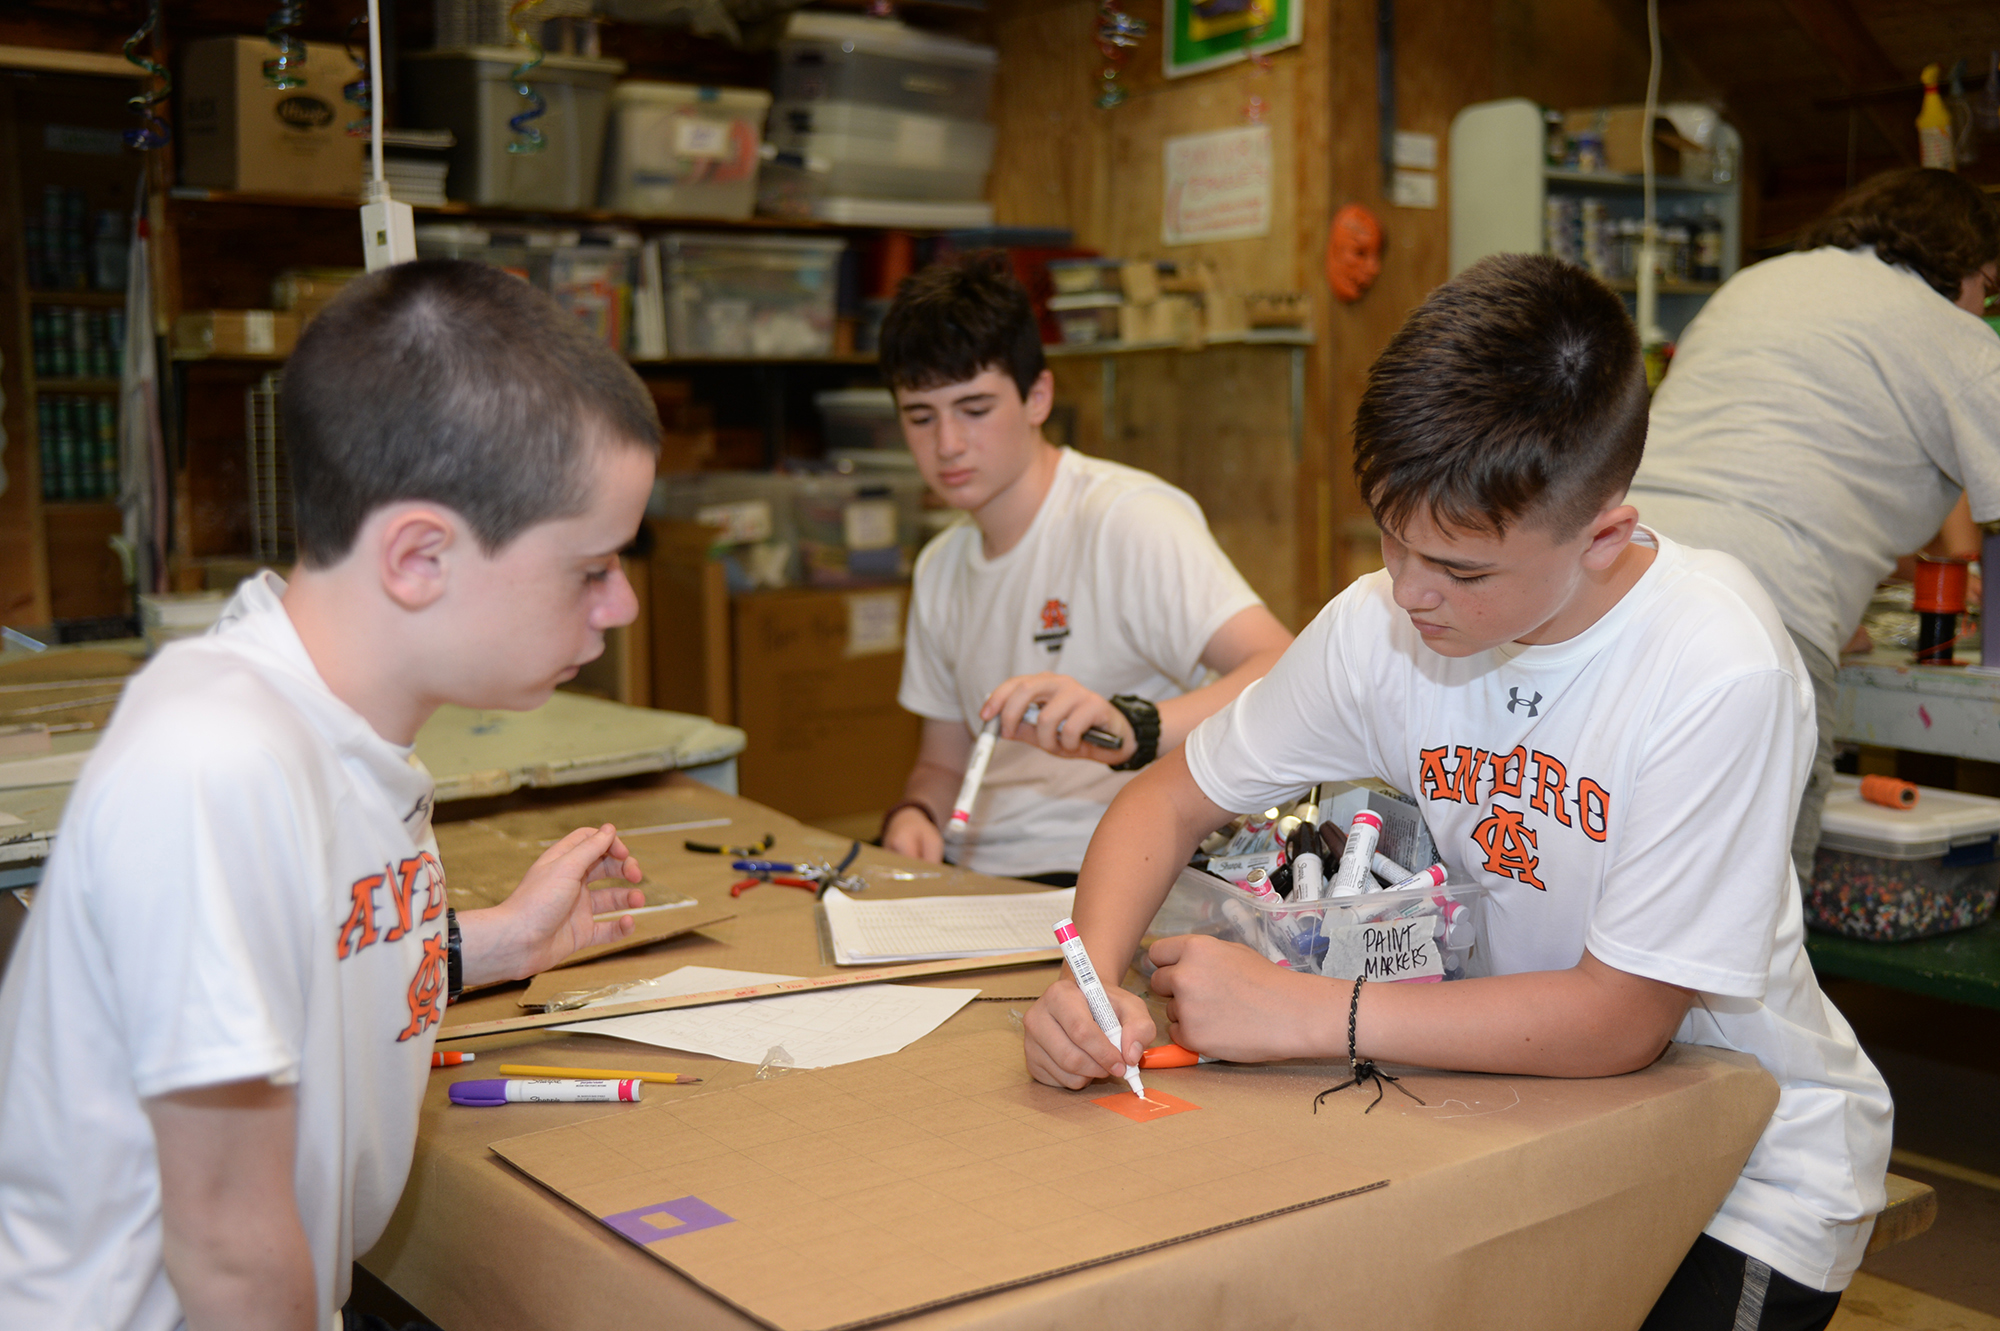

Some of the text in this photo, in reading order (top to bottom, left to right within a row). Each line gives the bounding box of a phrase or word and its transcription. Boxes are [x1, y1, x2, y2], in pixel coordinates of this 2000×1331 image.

[1419, 744, 1610, 843] ANDRO
[1362, 922, 1417, 953] PAINT
[1364, 943, 1428, 979] MARKERS
